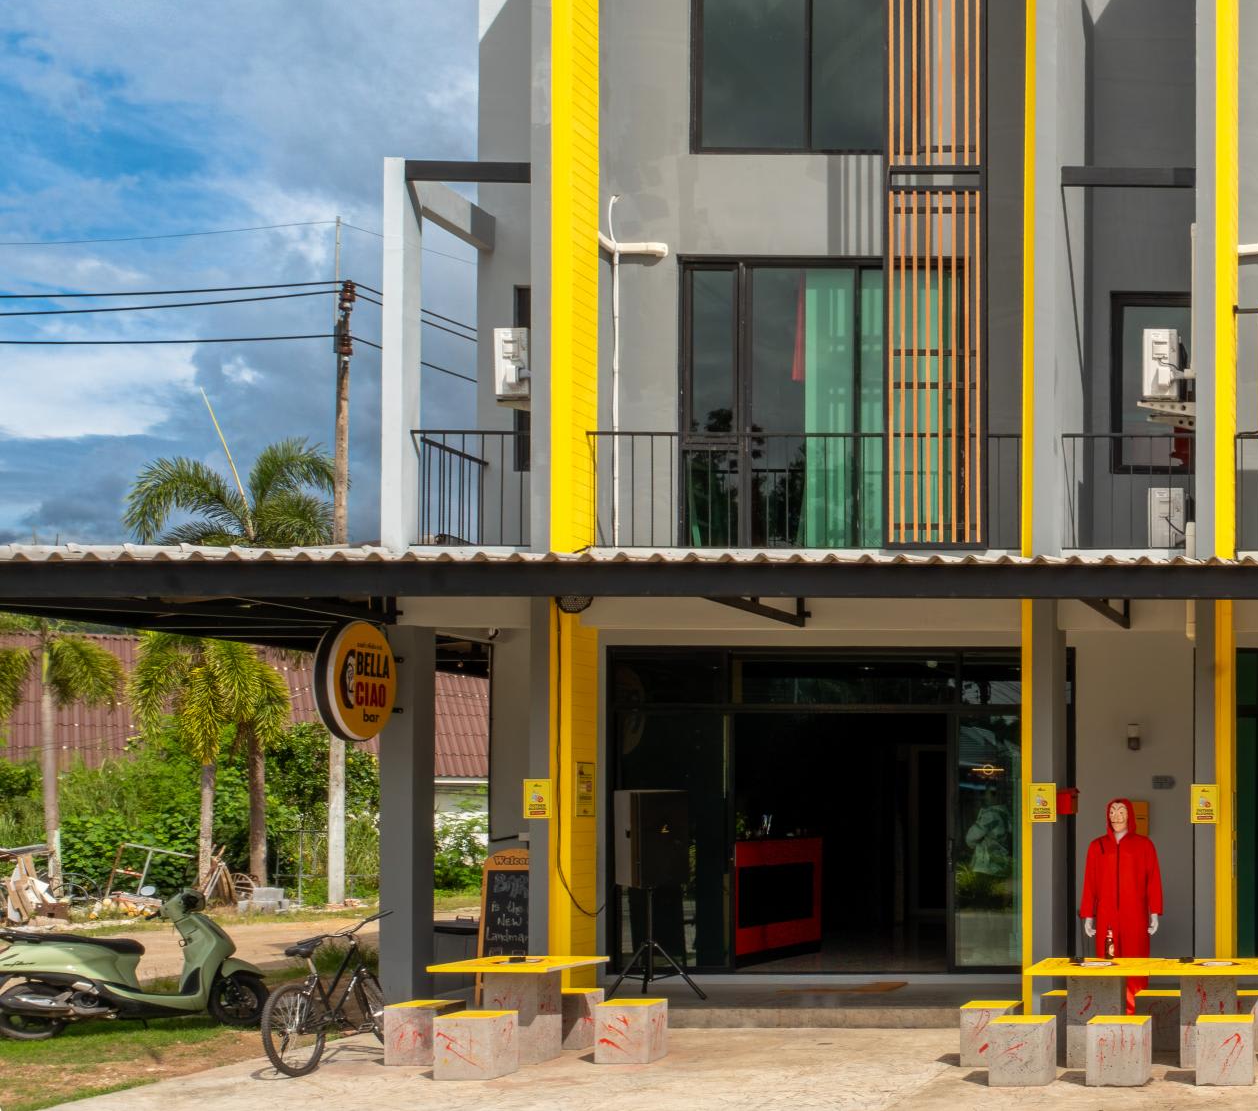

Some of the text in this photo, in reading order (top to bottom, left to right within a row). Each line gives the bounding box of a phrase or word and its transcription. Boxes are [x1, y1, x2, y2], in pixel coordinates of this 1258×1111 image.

[356, 651, 390, 679] BELLA
[355, 681, 386, 708] CIAO
[362, 708, 380, 723] bar
[493, 855, 530, 866] Welco
[486, 925, 529, 944] Landmar
